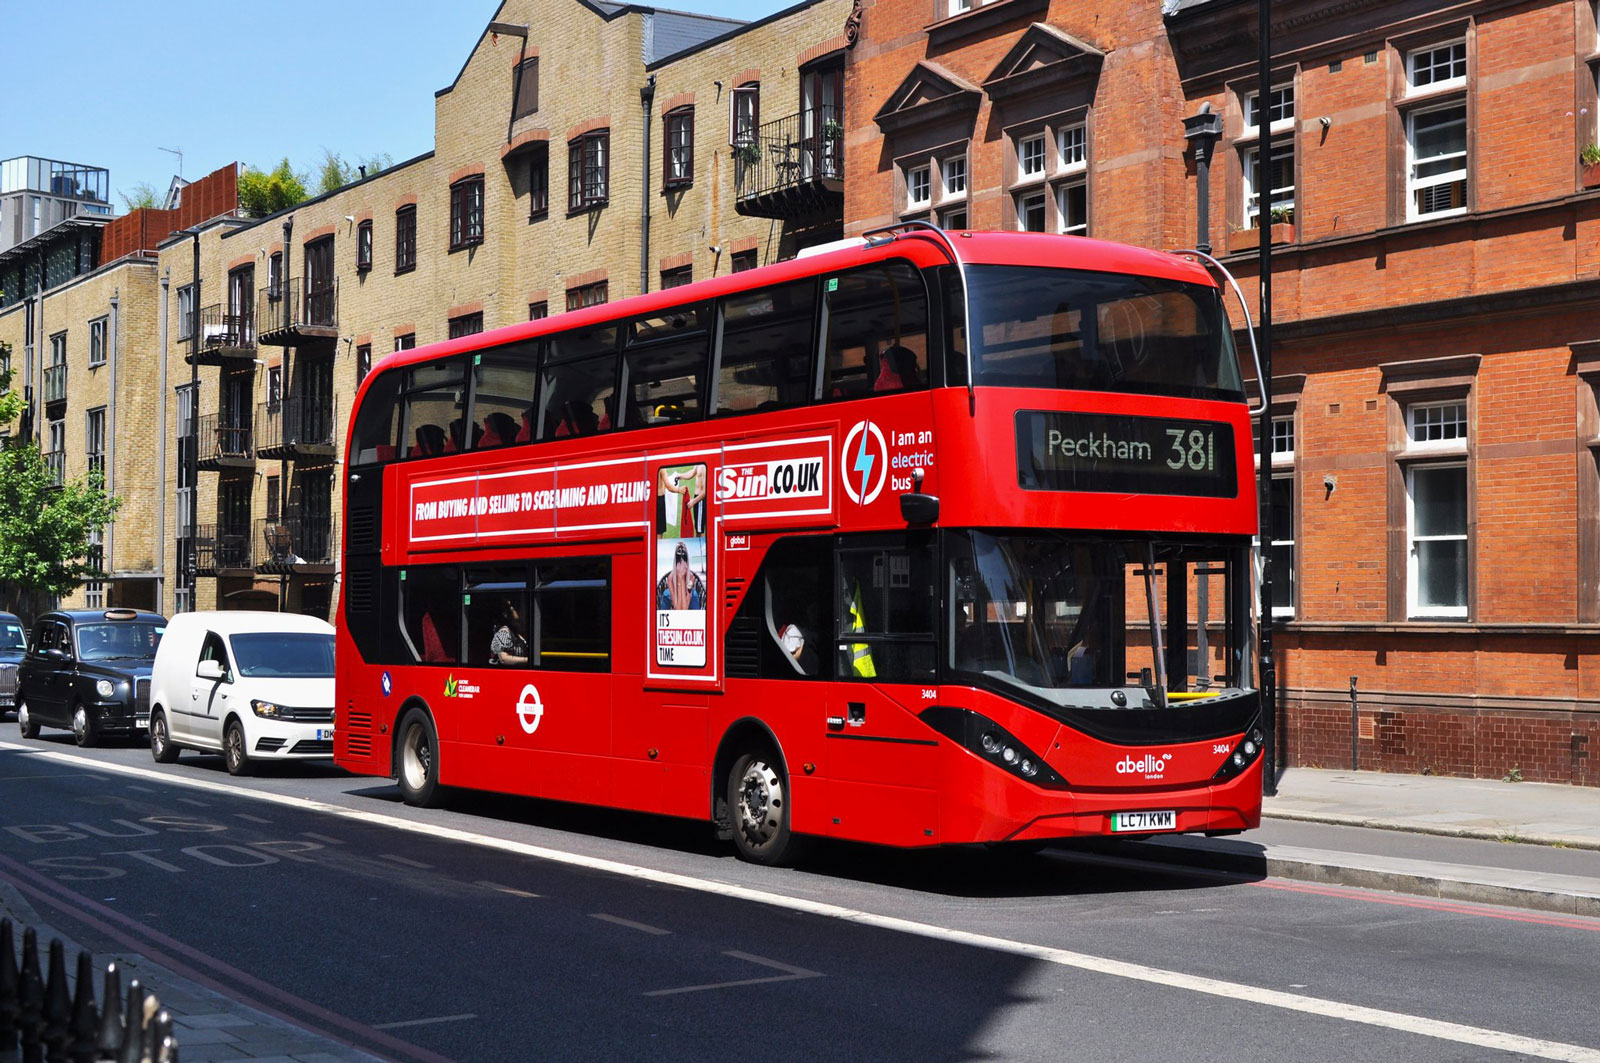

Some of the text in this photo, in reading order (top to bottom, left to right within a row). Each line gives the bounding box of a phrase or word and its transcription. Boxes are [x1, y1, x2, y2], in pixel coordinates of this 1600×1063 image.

[891, 430, 932, 447] I am an
[1048, 428, 1214, 471] Peckham 381
[891, 450, 934, 469] electric
[741, 467, 754, 476] THE
[891, 474, 911, 491] bus
[415, 480, 651, 521] FROM BUYING AND SELLING TO SCREAMING AND YELLING
[659, 613, 670, 627] IT'S
[659, 630, 703, 646] THESUN.CO.UK
[659, 647, 674, 662] TIME
[921, 689, 937, 699] 3404
[1212, 744, 1230, 754] 3404
[1116, 754, 1165, 774] abellio
[1121, 812, 1172, 828] LC71 KWM
[2, 815, 229, 843] BUS
[28, 840, 325, 880] STOP
